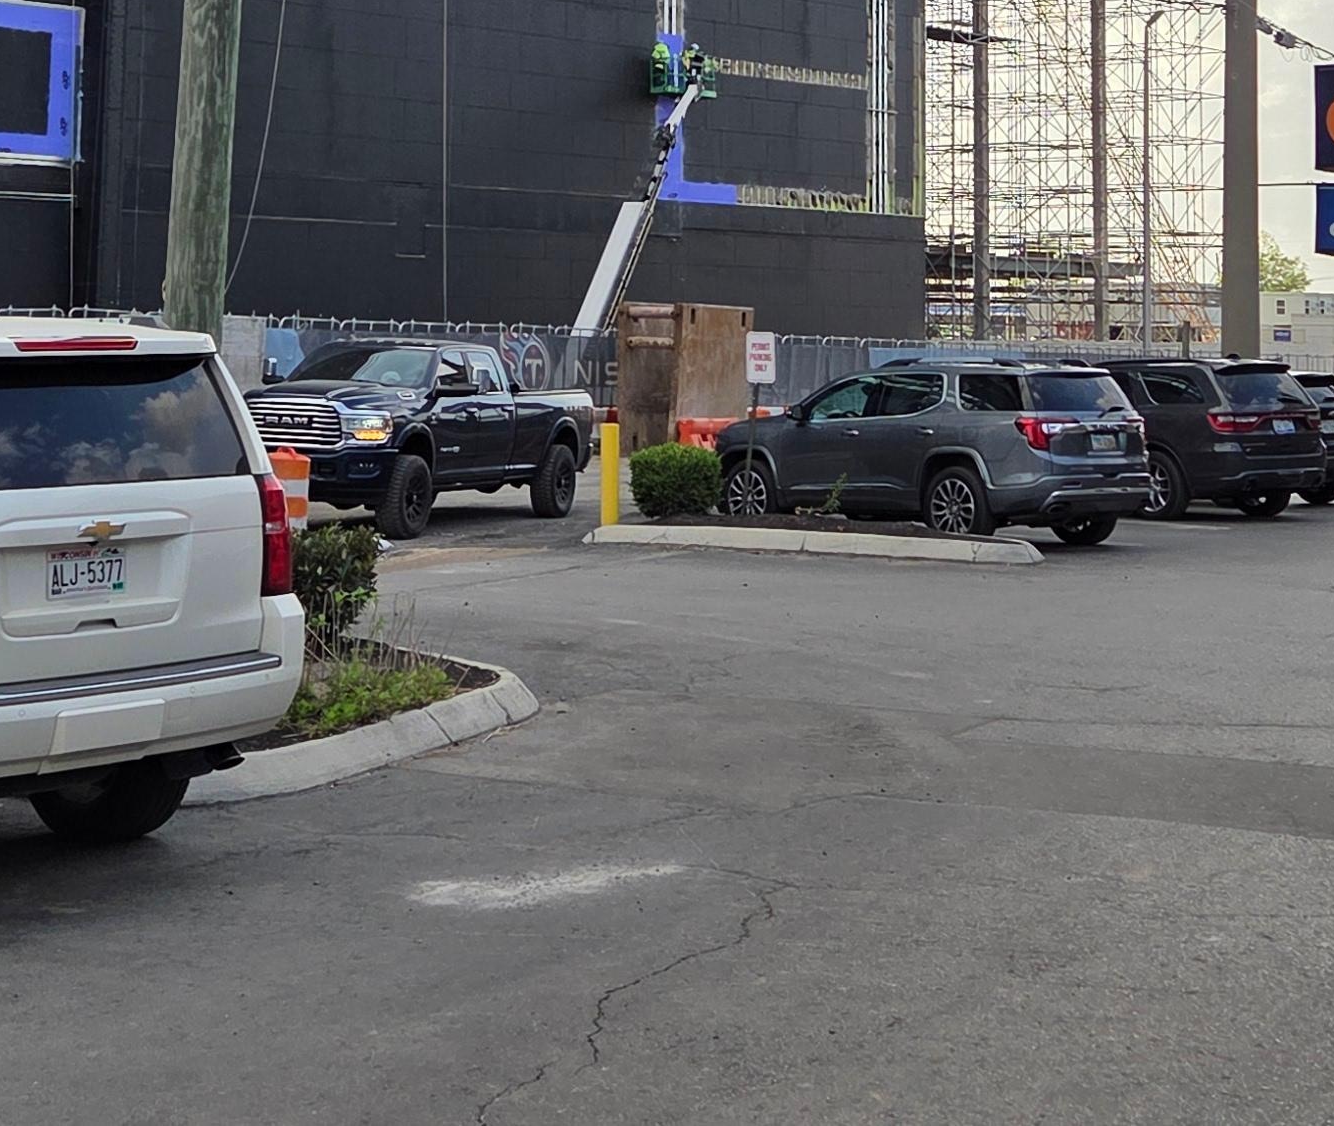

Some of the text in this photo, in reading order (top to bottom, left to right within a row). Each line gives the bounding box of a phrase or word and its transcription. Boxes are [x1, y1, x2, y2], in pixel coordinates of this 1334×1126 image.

[573, 359, 618, 386] NIS
[265, 416, 309, 425] RAM
[51, 558, 123, 588] ALJ-5377
